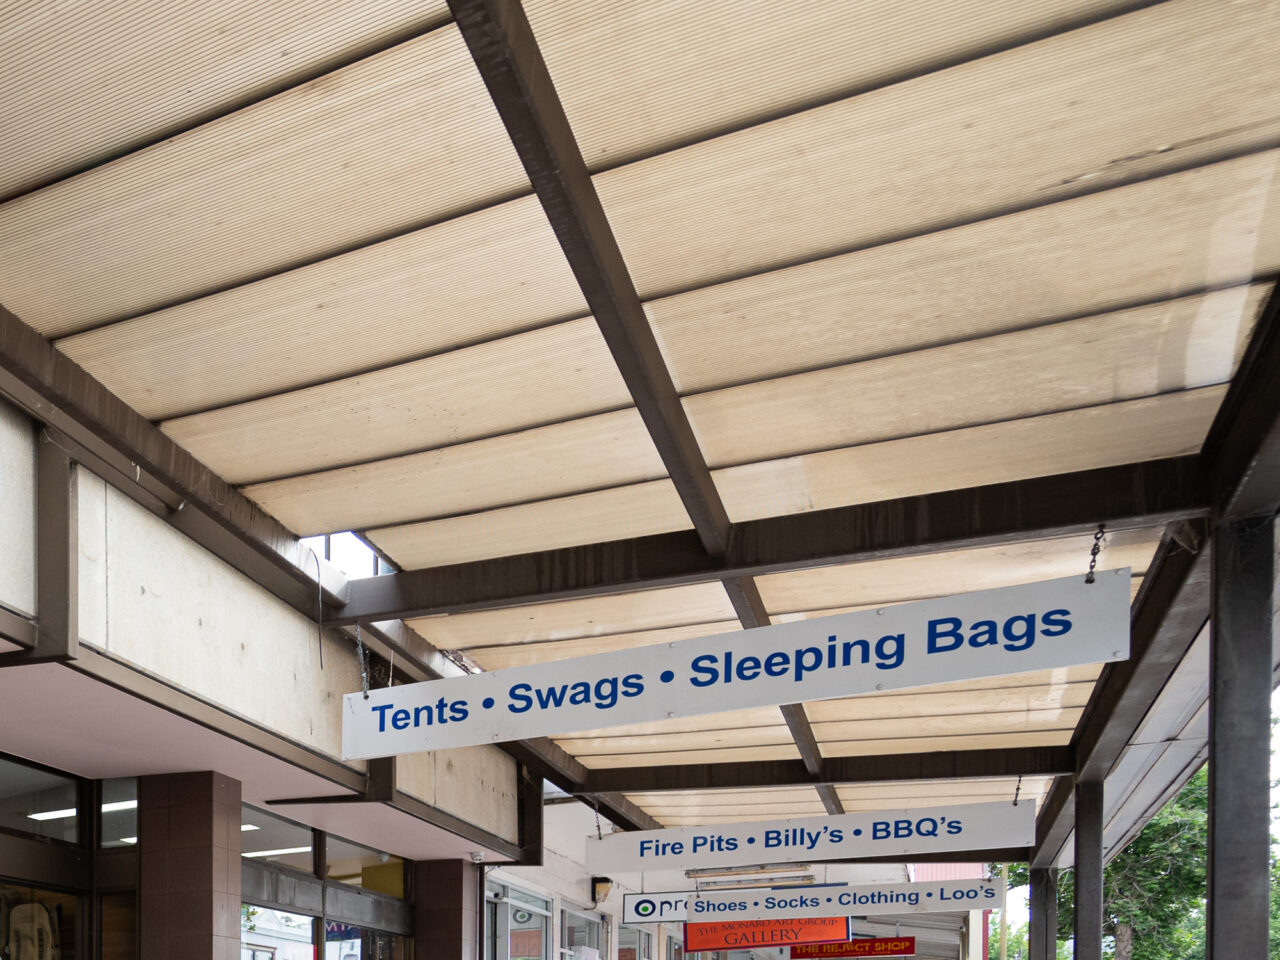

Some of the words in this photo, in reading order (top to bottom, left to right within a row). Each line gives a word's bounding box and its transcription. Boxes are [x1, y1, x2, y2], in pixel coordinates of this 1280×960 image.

[371, 697, 469, 733] Tents
[507, 674, 645, 714] Swags
[689, 634, 905, 688] Sleeping
[927, 608, 1073, 655] Bags
[639, 839, 684, 857] Fire
[692, 836, 739, 853] Pits
[764, 827, 844, 851] Billy's
[872, 816, 963, 841] BBQ's
[694, 900, 748, 913] Shoes
[765, 894, 820, 910] Socks
[838, 891, 919, 907] Clothing
[939, 886, 996, 901] Loo's
[697, 926, 718, 936] THE
[724, 928, 802, 945] GALLERY
[796, 944, 819, 954] THE
[823, 942, 870, 953] REJECT
[875, 940, 910, 951] SHOP
